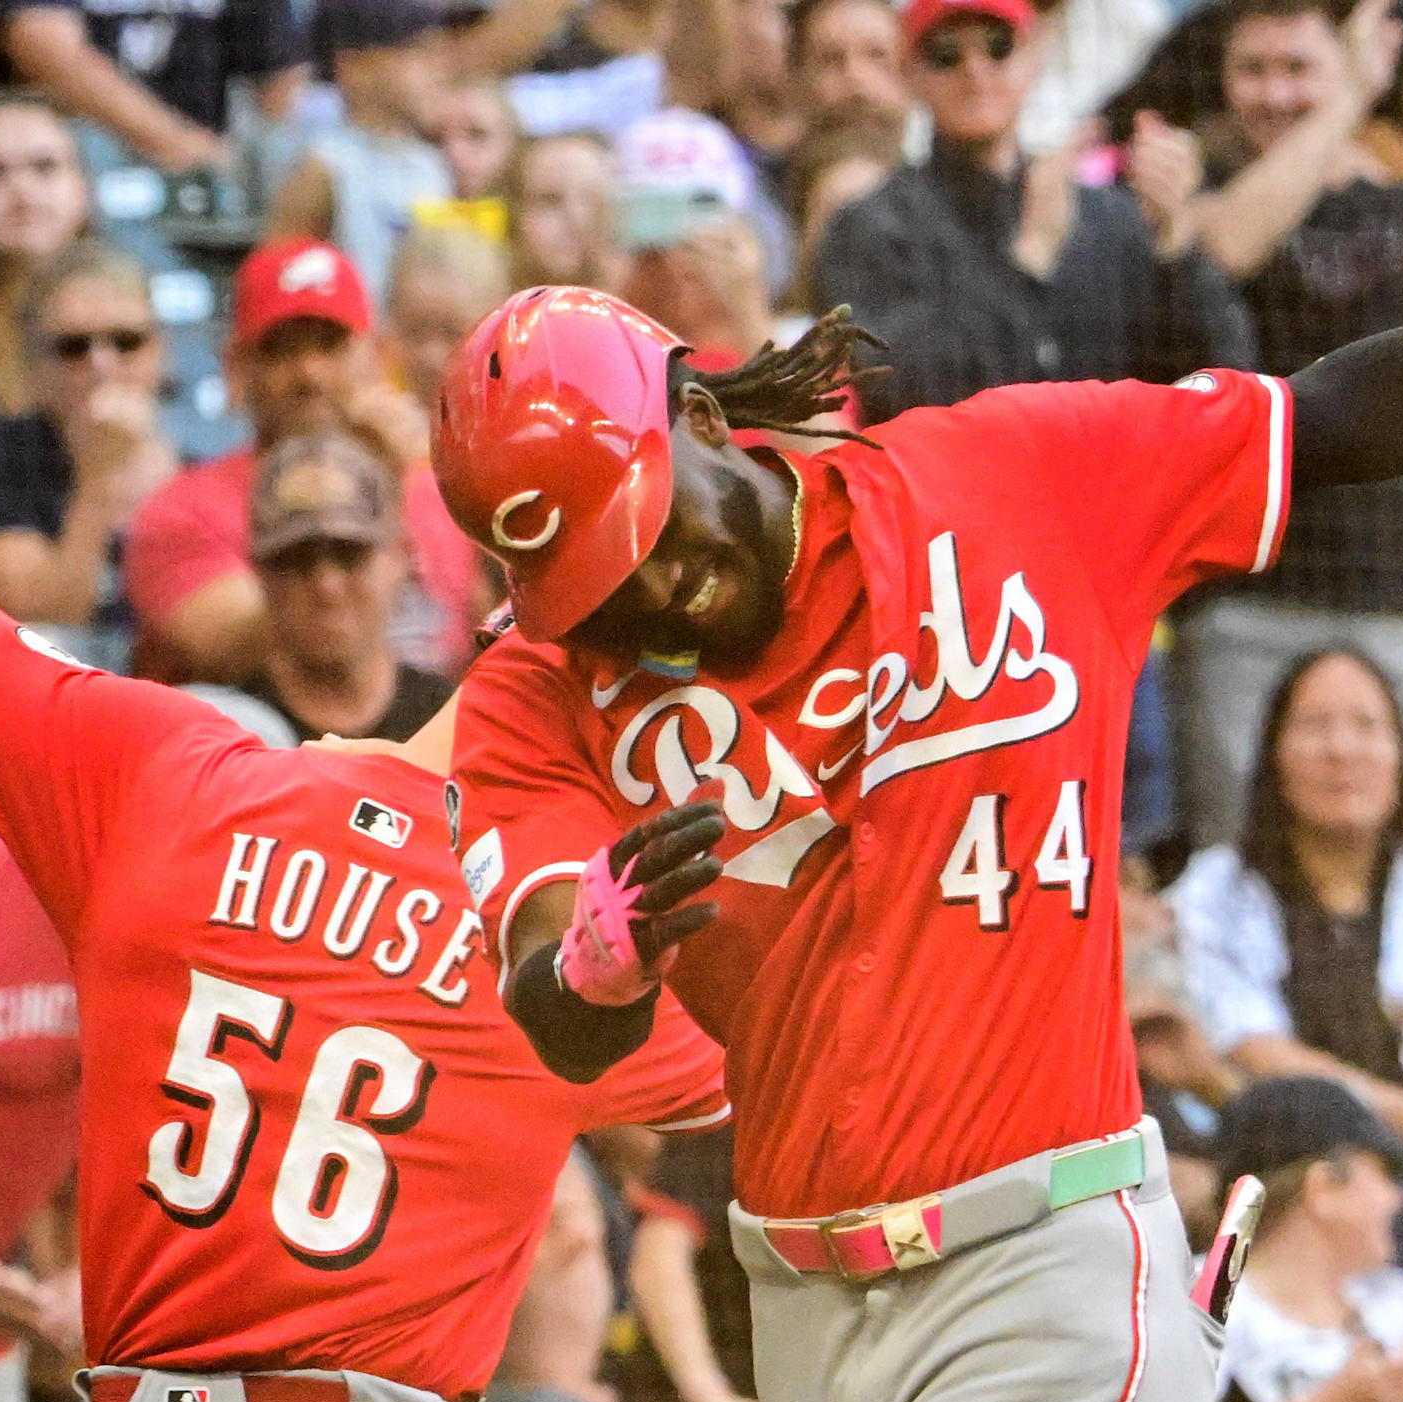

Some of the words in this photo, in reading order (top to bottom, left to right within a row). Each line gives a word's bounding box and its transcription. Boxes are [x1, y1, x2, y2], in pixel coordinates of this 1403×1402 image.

[491, 490, 561, 550] C
[208, 832, 486, 1010] HOUSE
[939, 780, 1092, 932] 44
[138, 968, 437, 1271] 56
